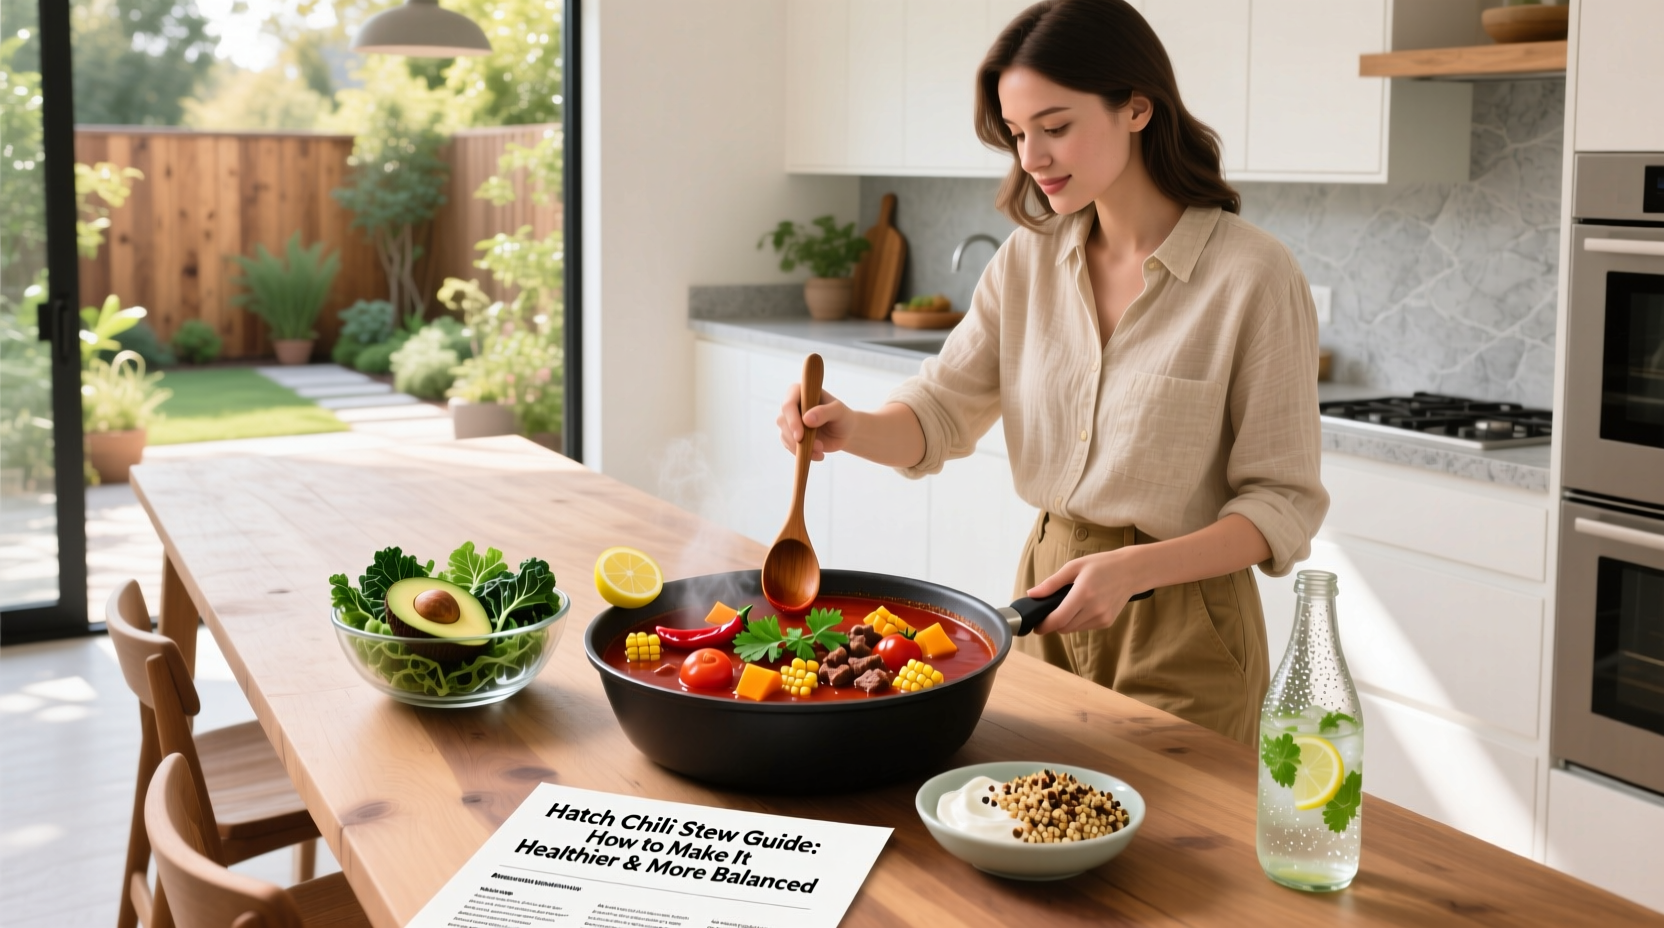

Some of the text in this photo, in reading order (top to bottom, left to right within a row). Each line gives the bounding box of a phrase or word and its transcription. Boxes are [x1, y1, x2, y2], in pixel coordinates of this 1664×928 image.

[544, 802, 821, 855] Hatch Chili Stew Guide:
[585, 829, 753, 866] How to Make It
[514, 838, 820, 894] Healthier & More Balanced
